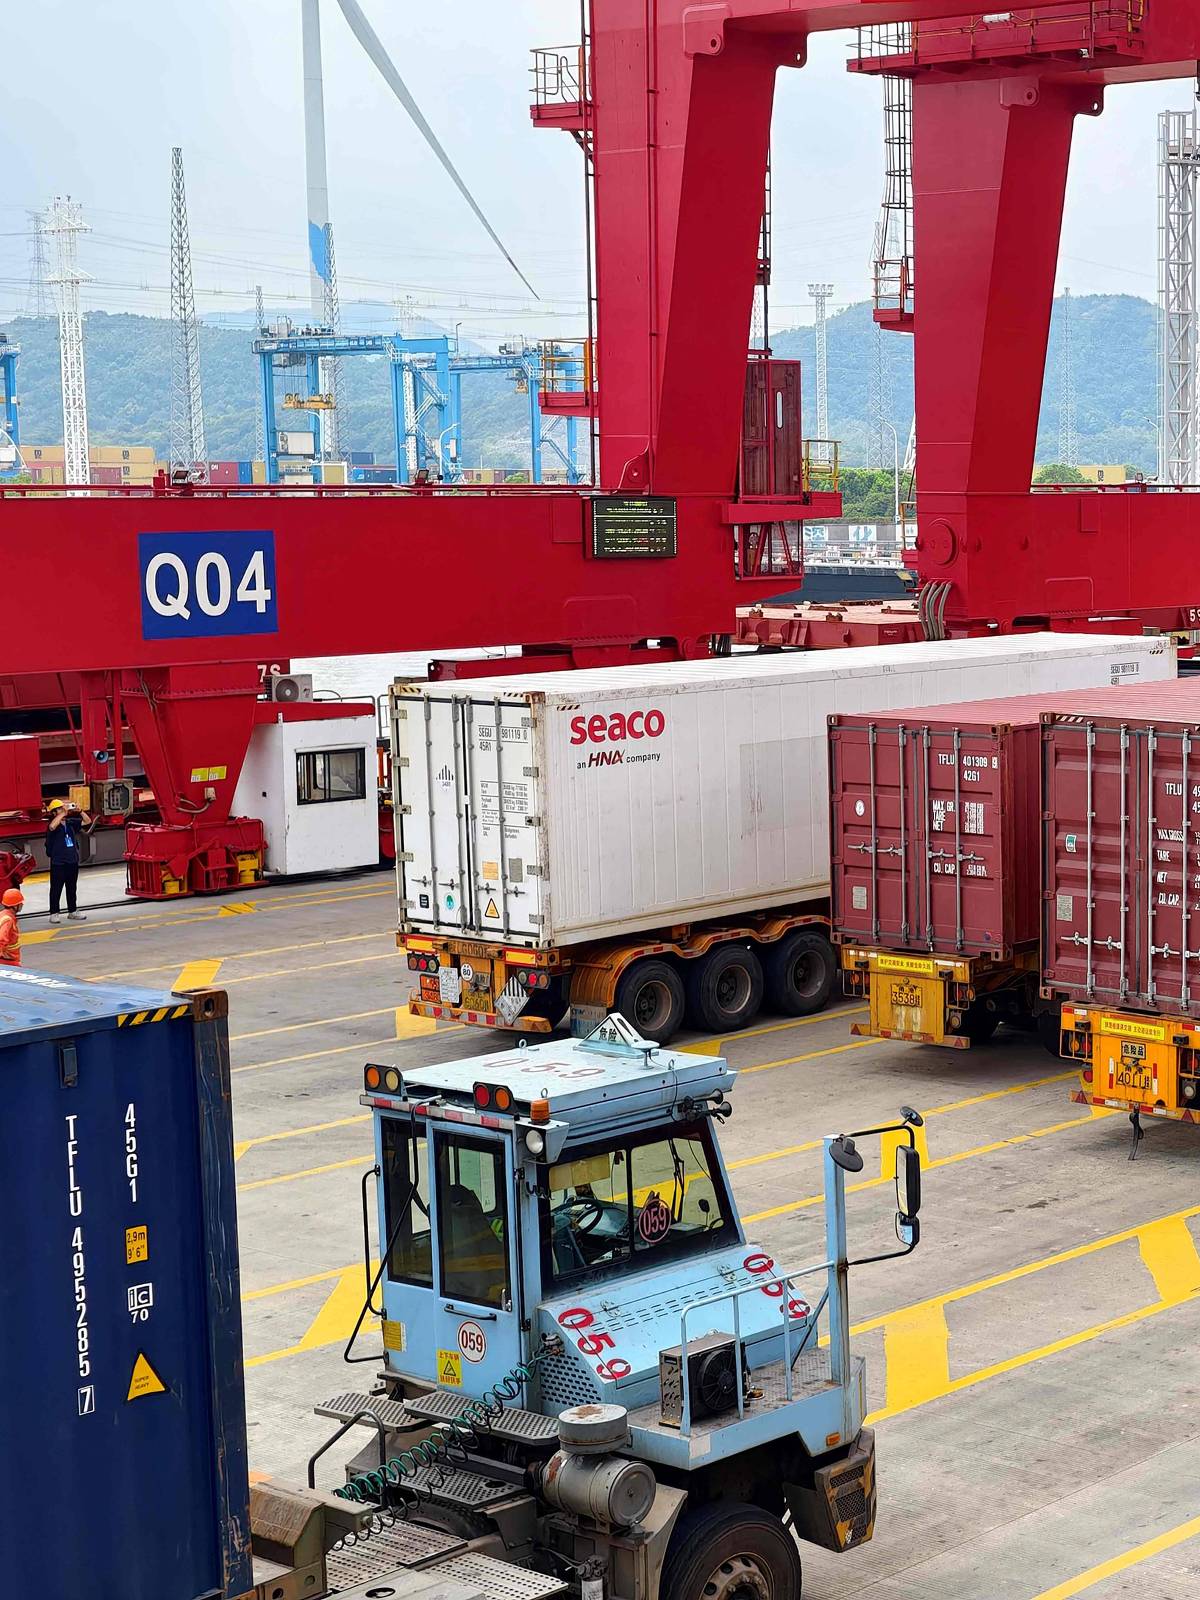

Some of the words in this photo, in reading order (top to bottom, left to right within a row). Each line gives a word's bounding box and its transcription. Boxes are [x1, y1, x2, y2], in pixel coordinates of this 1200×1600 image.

[145, 550, 272, 621] Q04
[478, 727, 492, 739] SEGU
[501, 728, 521, 740] 981119
[523, 729, 528, 741] 0
[569, 709, 666, 746] seaco
[479, 741, 492, 752] 45R1
[576, 761, 587, 770] an
[588, 748, 626, 768] HNA
[626, 752, 661, 764] company
[938, 753, 955, 766] TFLU
[962, 755, 988, 768] 401309
[963, 769, 980, 782] 42G1
[1165, 782, 1183, 796] TFLU
[1156, 871, 1168, 884] NET
[462, 968, 471, 977] 80
[598, 1026, 618, 1043] 危险
[124, 1102, 138, 1203] 45G1
[65, 1114, 83, 1217] TFLU
[642, 1206, 667, 1234] 059
[71, 1226, 91, 1378] 495285
[130, 1309, 150, 1324] 70
[461, 1329, 484, 1354] 059
[557, 1307, 632, 1381] 059
[134, 1382, 150, 1391] HEAVY
[79, 1386, 93, 1414] 7
